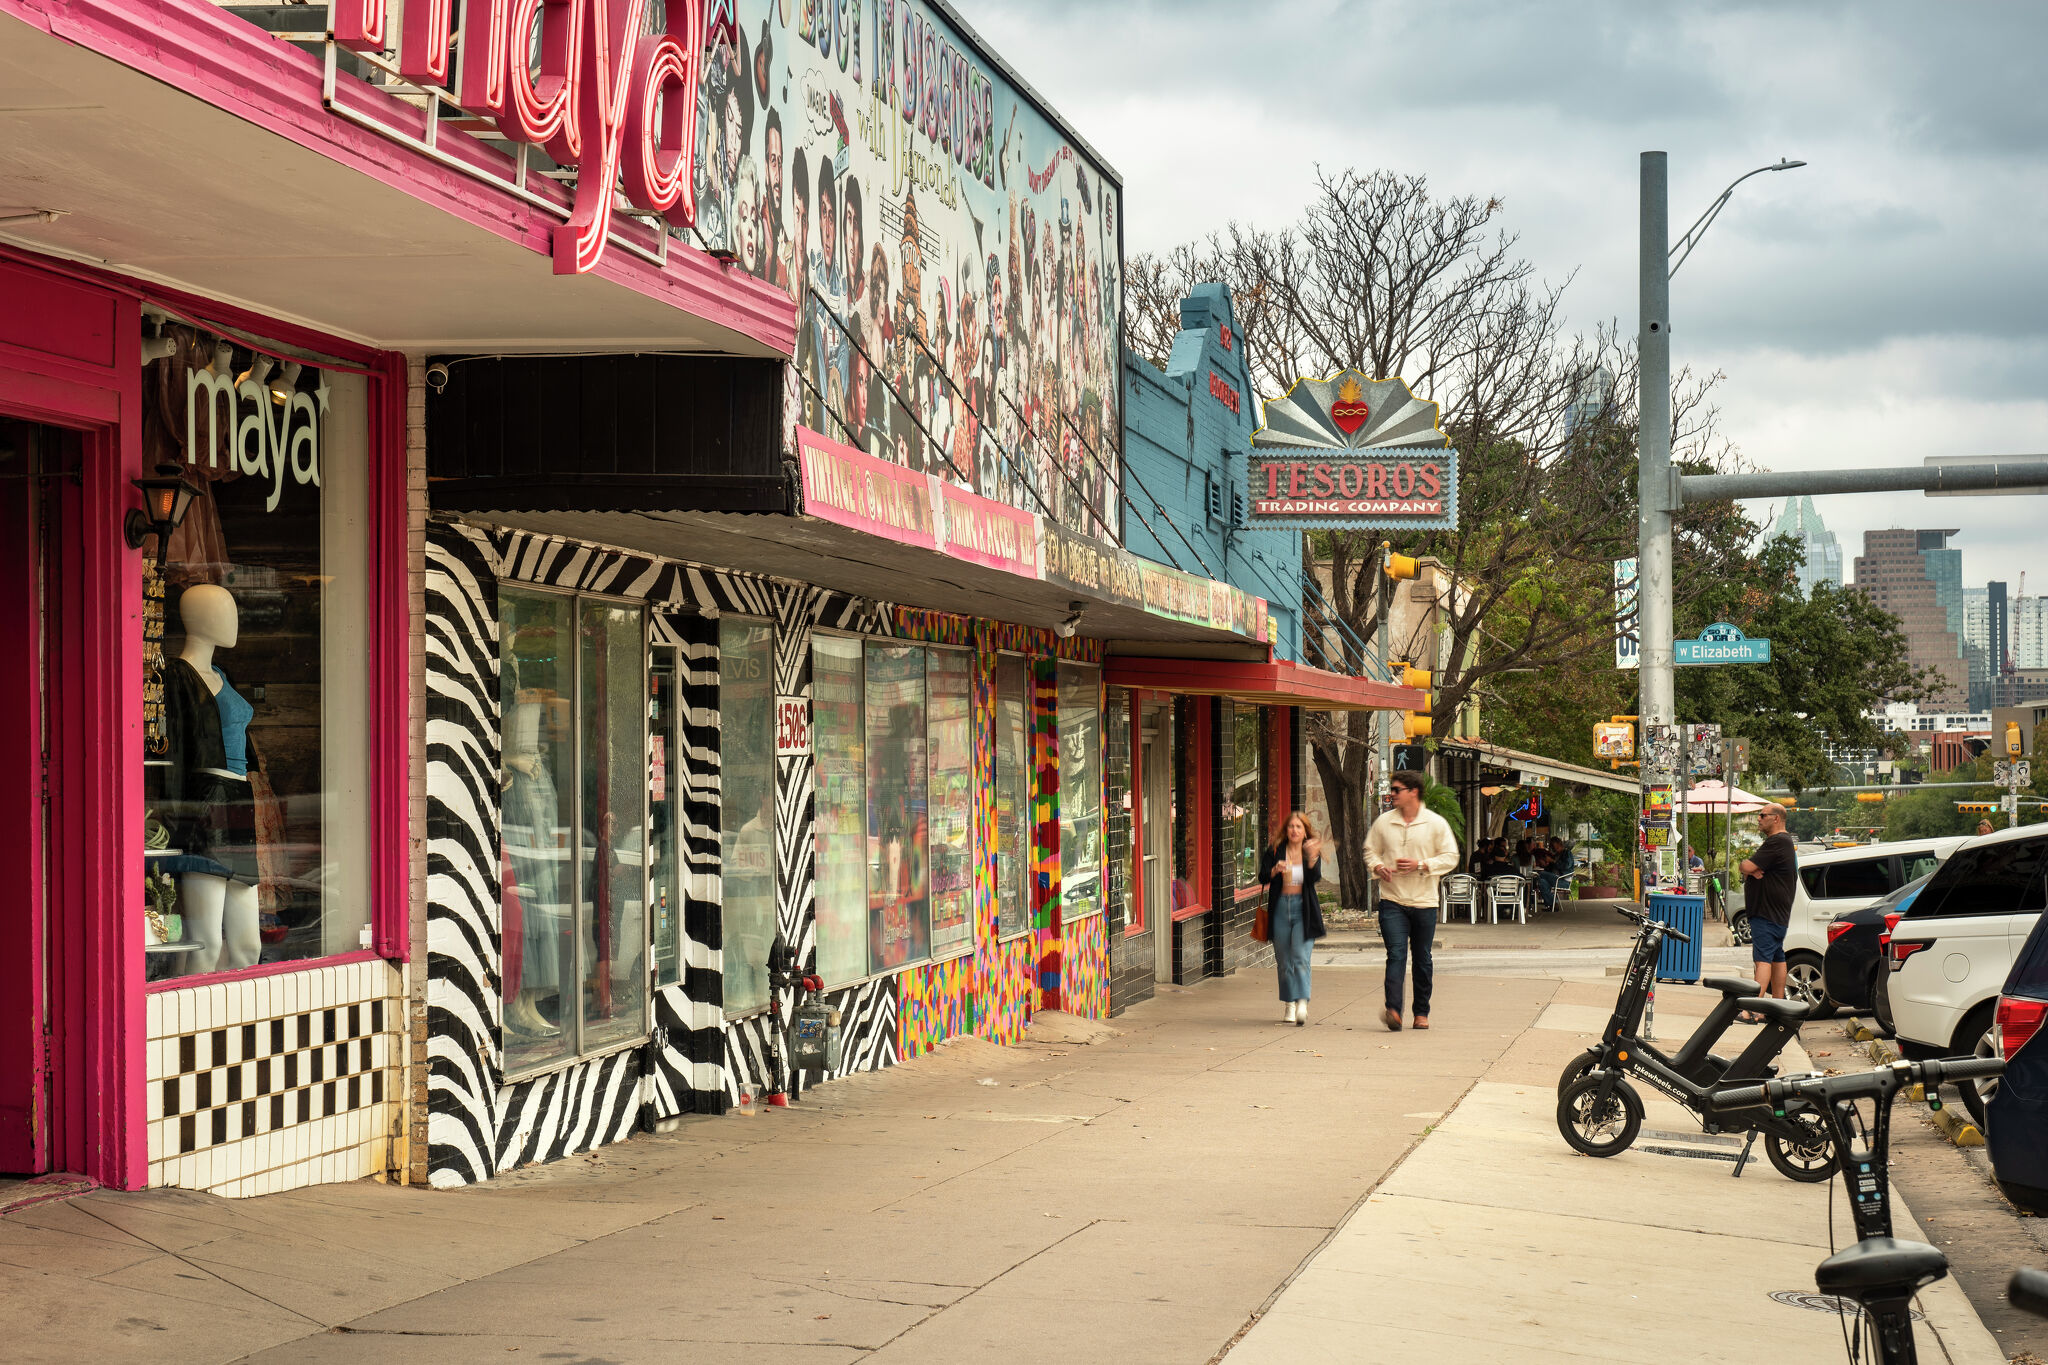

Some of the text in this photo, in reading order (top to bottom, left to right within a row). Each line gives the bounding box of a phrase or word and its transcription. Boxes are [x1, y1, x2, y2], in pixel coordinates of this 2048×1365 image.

[871, 0, 895, 110] IN
[901, 0, 995, 191] DISGUISE
[335, 0, 700, 275] aya
[890, 83, 957, 211] Diamonds
[1042, 156, 1056, 193] DREAM
[187, 367, 320, 512] maya
[803, 444, 934, 537] VINTAGE & OUTRAGEOUS
[1260, 462, 1441, 499] TESOROS
[1258, 500, 1439, 513] TRADING COMPANY
[1680, 647, 1687, 657] W
[1692, 644, 1752, 659] Elizabeth
[1703, 634, 1741, 642] CONGRESS
[778, 703, 807, 749] 1506
[1443, 749, 1473, 759] ATM
[738, 851, 766, 868] ELVIS
[1641, 965, 1653, 990] WHEELS
[1633, 1063, 1688, 1100] takewheels.com
